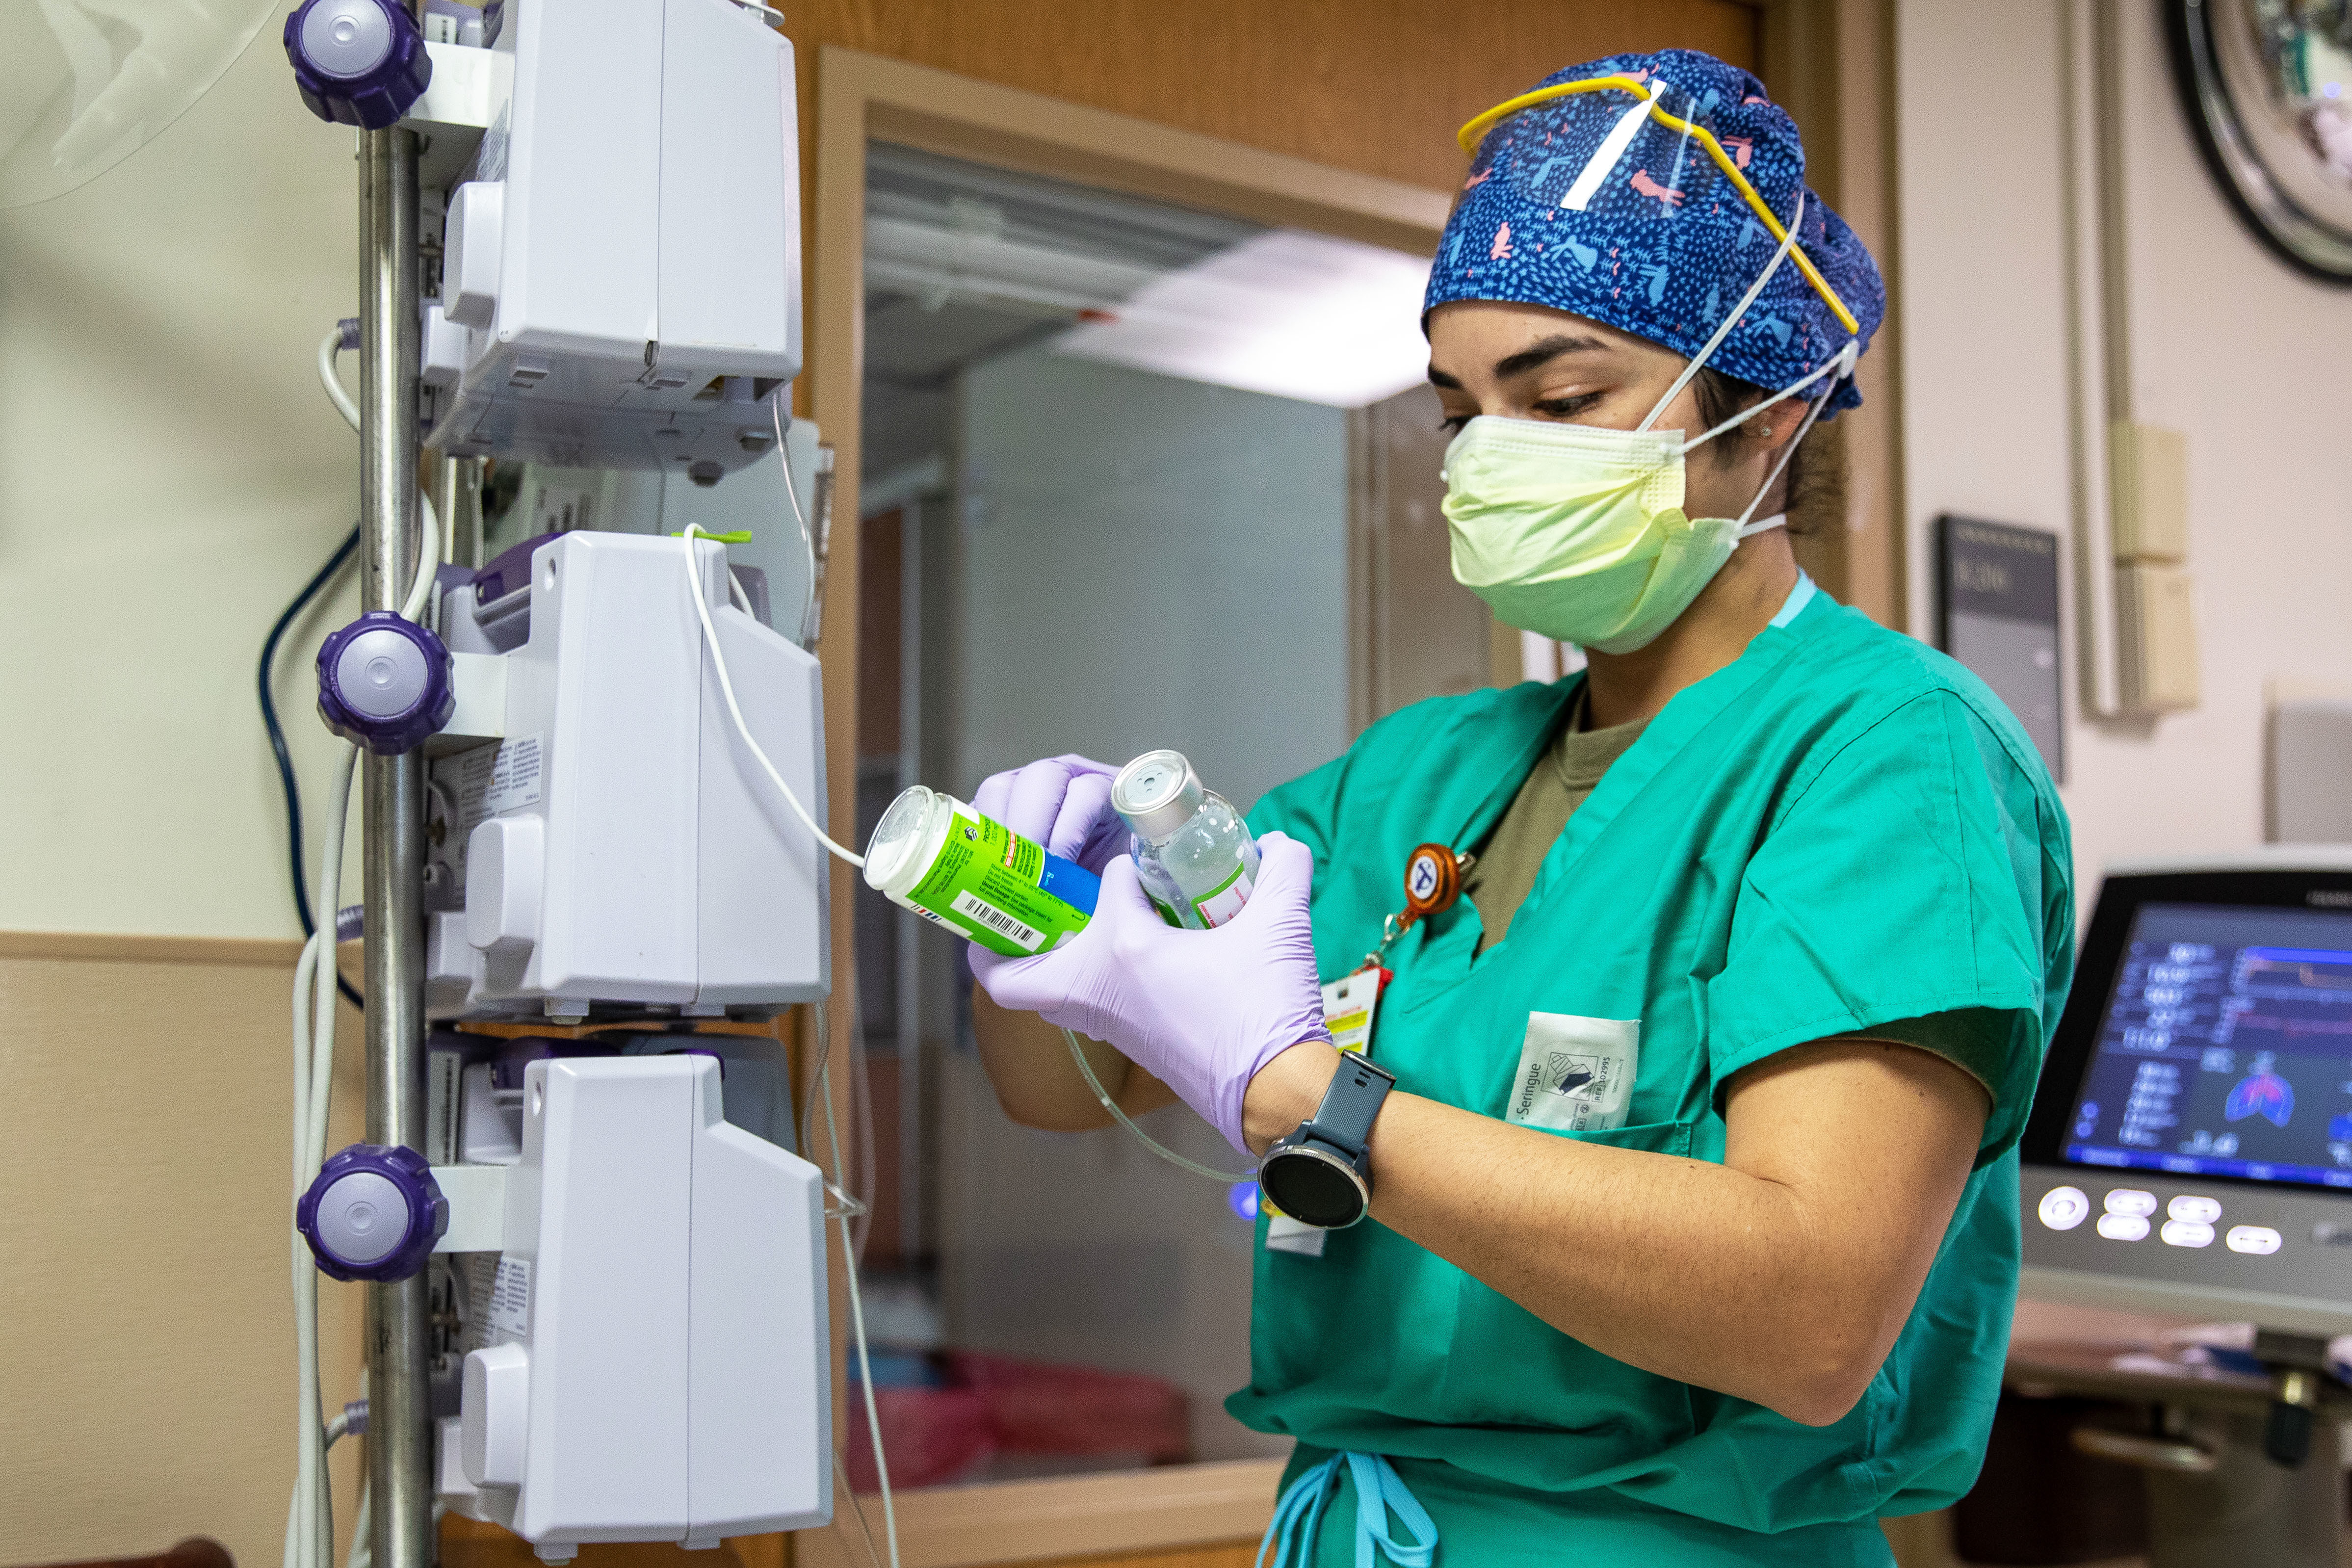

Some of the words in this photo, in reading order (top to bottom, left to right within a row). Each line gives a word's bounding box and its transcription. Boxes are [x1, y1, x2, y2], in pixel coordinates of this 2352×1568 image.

[991, 863, 1001, 872] Store
[1001, 869, 1018, 881] between
[985, 875, 1000, 887] Discard
[1000, 885, 1015, 894] unused
[982, 880, 994, 890] Usual
[1018, 902, 1035, 914] package
[1035, 911, 1047, 919] insert
[985, 890, 1007, 906] prescribing
[1516, 1063, 1541, 1115] Seringue
